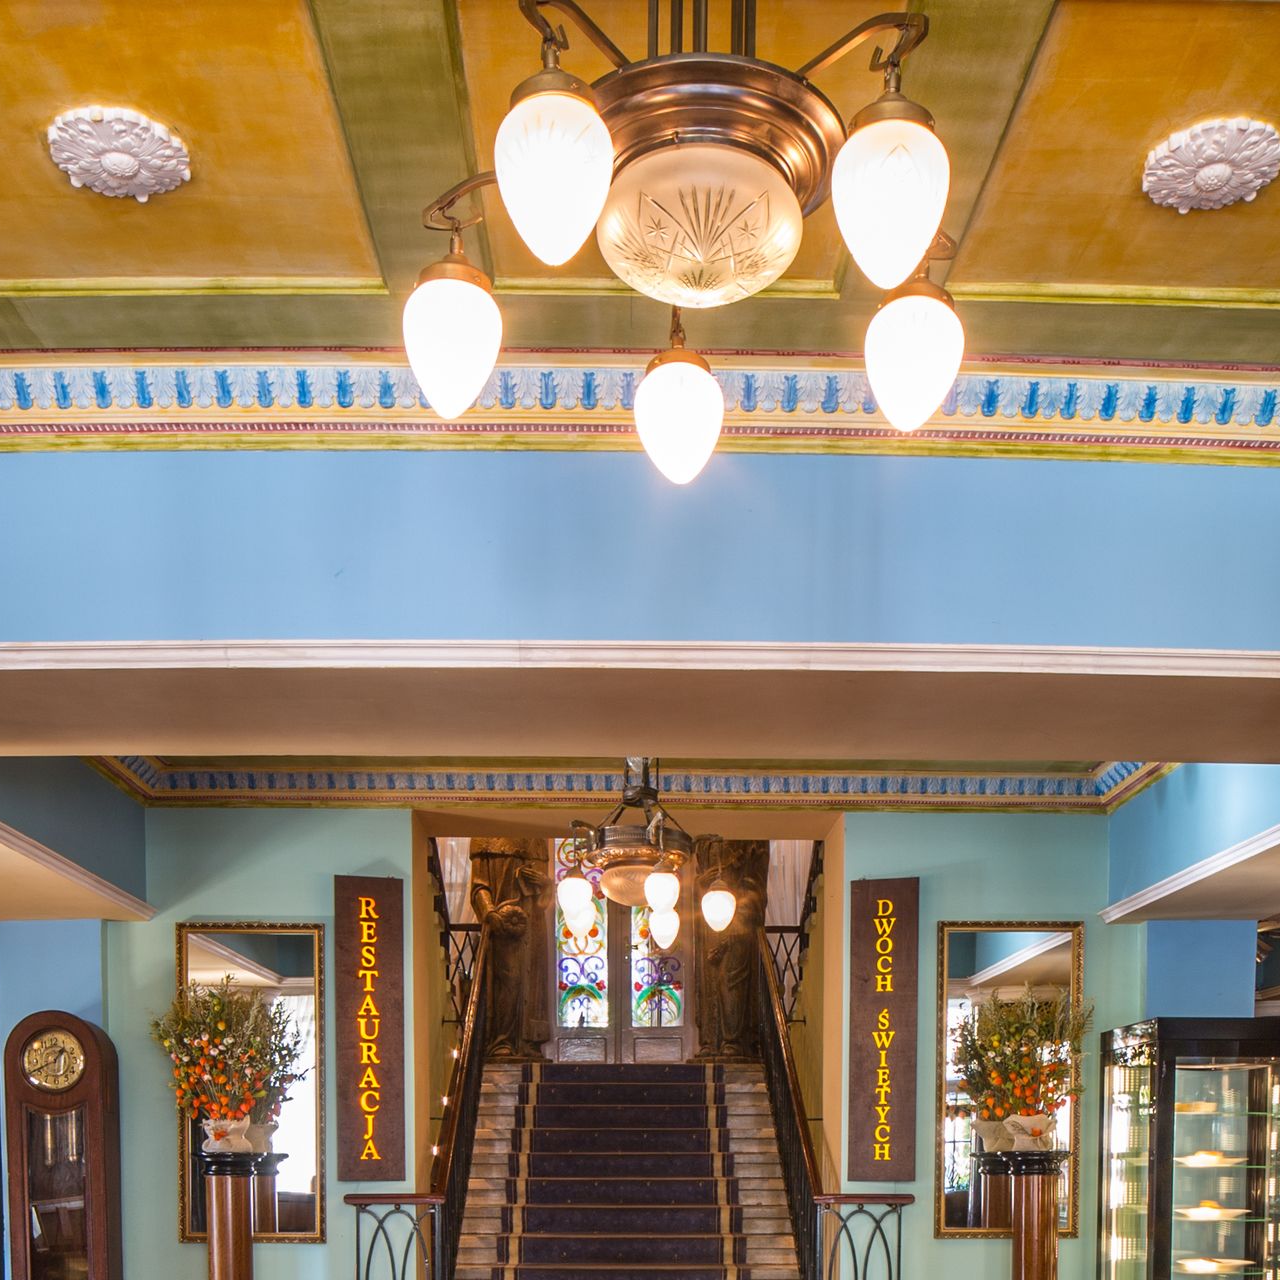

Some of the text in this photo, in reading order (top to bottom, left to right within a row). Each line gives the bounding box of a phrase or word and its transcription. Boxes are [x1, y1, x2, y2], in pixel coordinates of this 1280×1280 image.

[357, 896, 382, 1161] RESTAURACJA
[871, 899, 897, 1161] DWÓCH ŚWIĘTYCH
